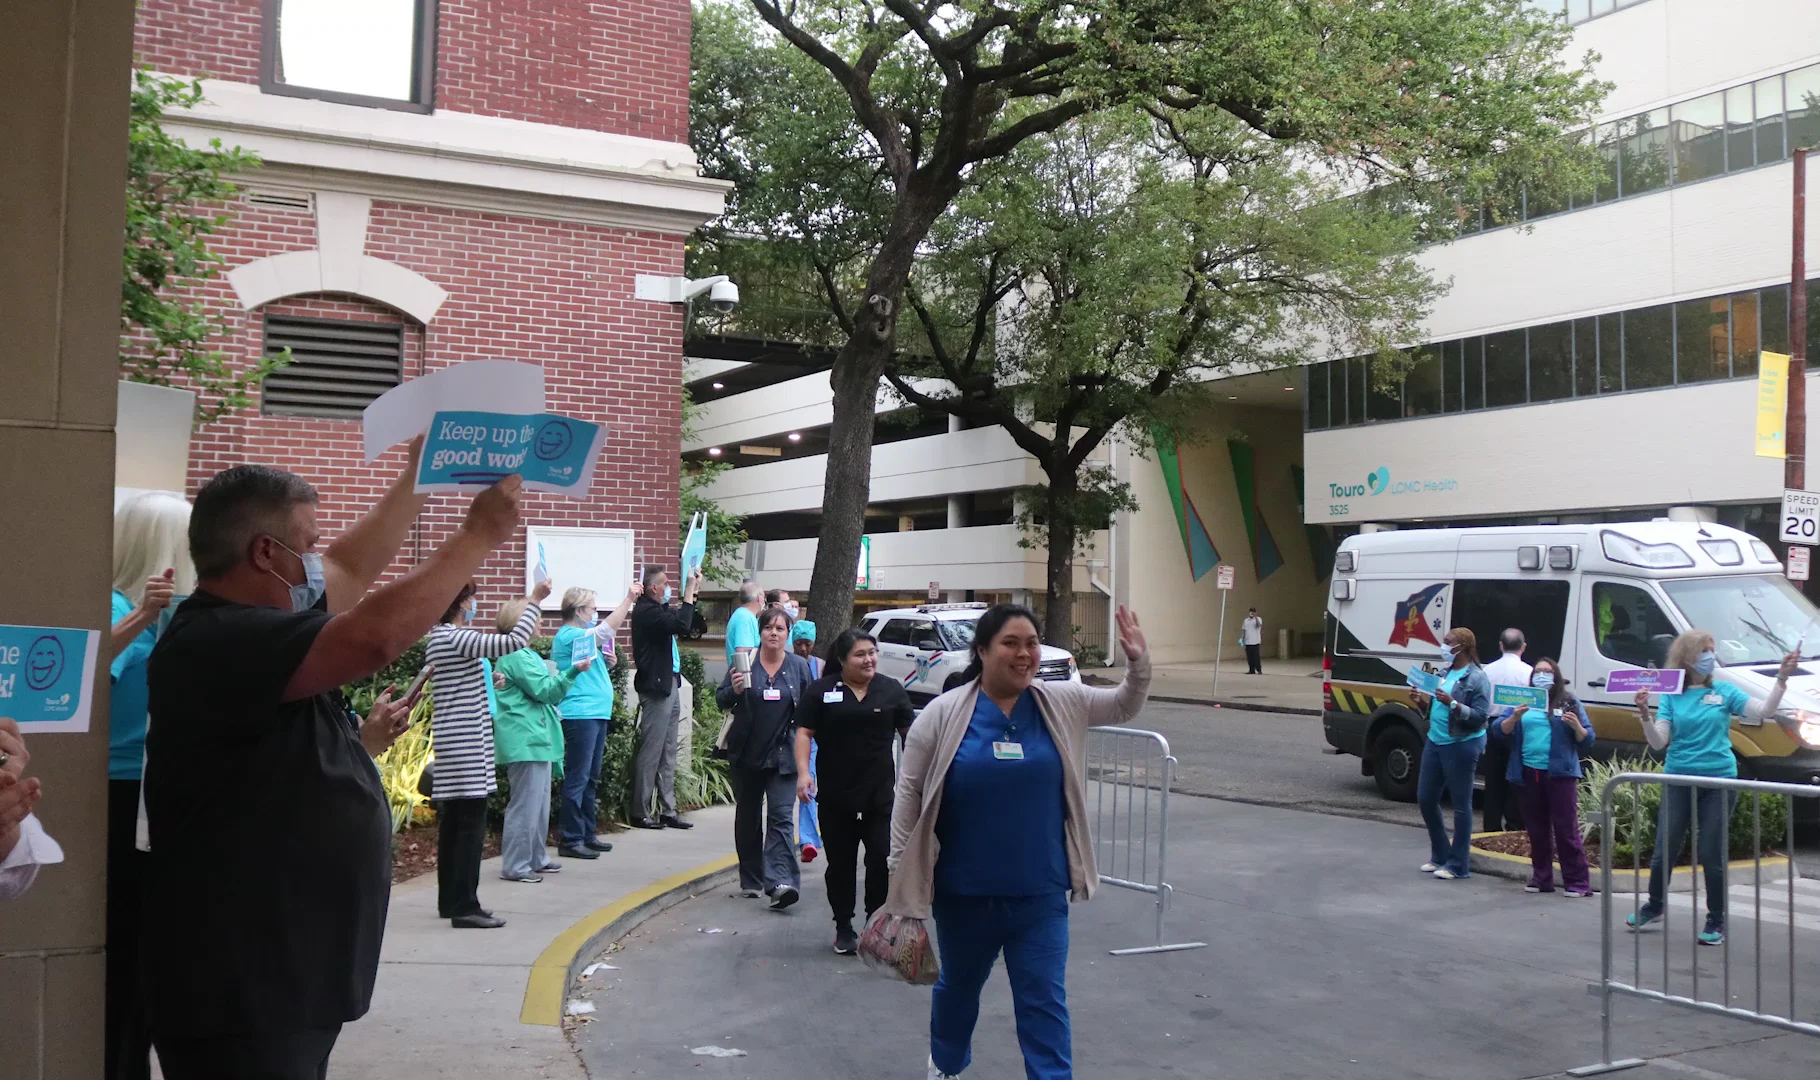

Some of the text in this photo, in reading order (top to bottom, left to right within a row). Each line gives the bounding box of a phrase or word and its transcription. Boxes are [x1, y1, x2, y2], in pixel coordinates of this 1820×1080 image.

[438, 421, 535, 448] Keep up the
[431, 447, 483, 470] good
[1329, 478, 1459, 498] Touro LCMC Health
[1329, 504, 1349, 515] 3525
[1786, 495, 1819, 506] SPEED
[1788, 506, 1815, 516] LIMIT
[1785, 516, 1816, 537] 20
